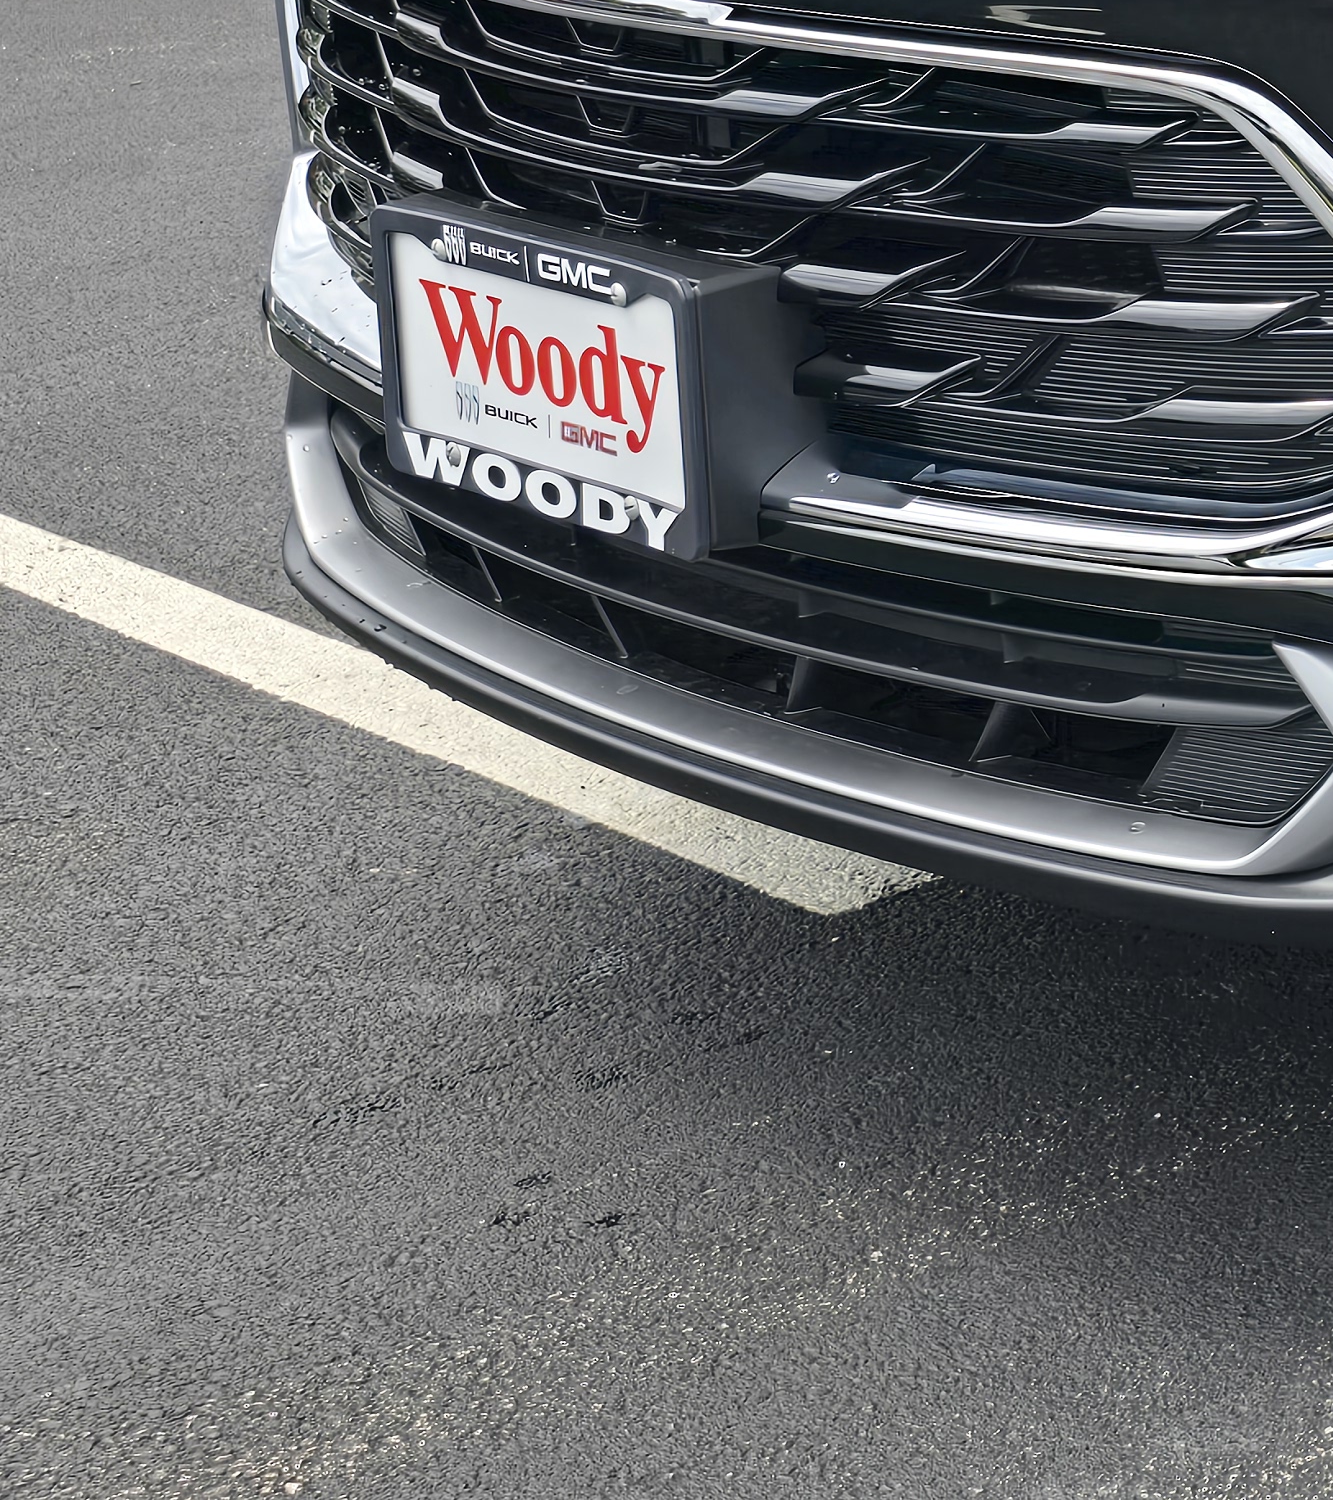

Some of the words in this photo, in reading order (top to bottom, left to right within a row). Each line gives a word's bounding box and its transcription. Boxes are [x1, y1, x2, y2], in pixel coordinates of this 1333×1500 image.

[469, 241, 520, 266] BUICK
[537, 252, 611, 293] GMC
[418, 278, 666, 453] Woody
[484, 404, 538, 429] BUICK
[560, 421, 618, 456] GMC
[402, 431, 679, 551] WOODY
